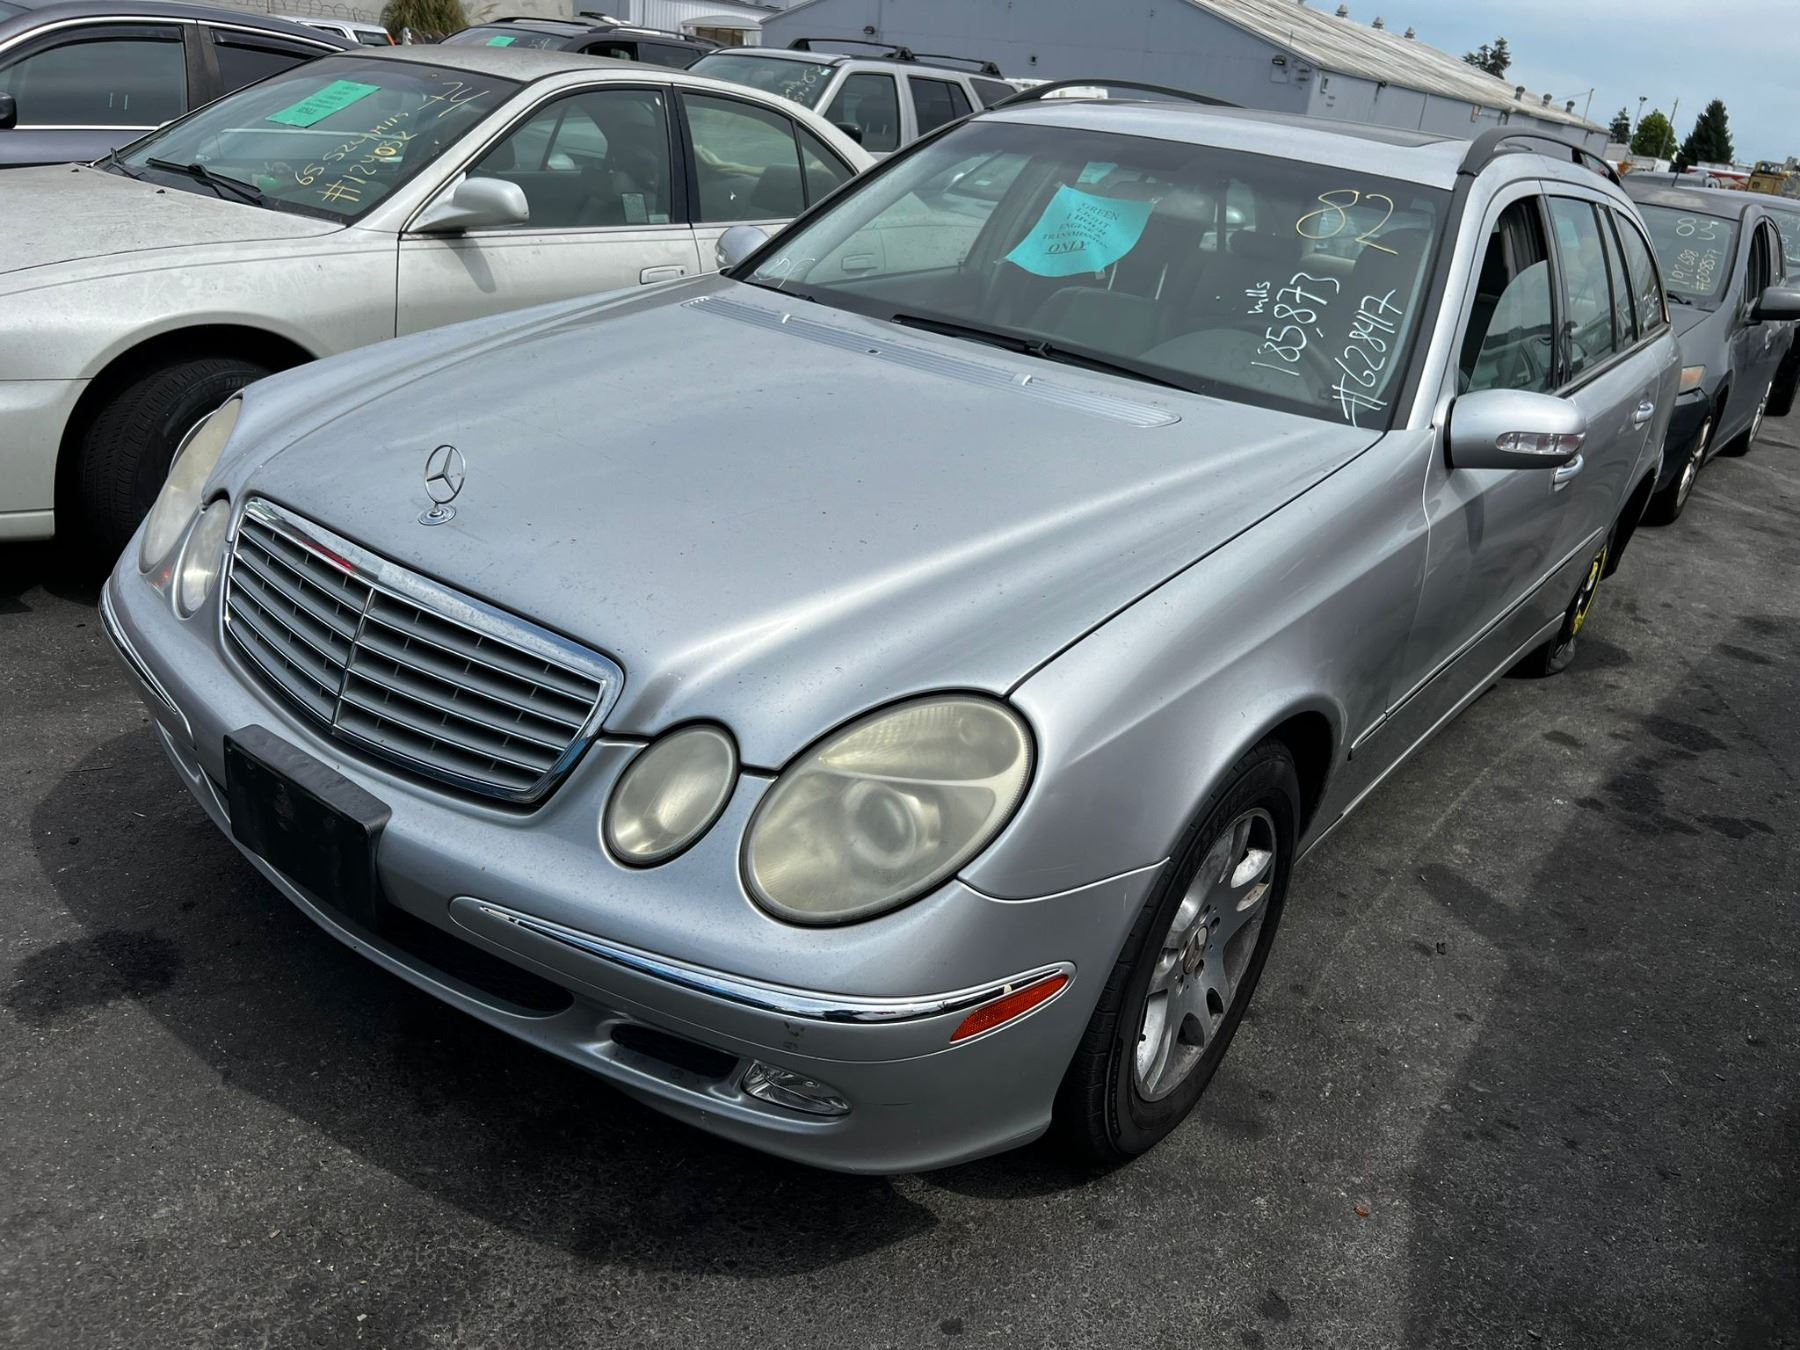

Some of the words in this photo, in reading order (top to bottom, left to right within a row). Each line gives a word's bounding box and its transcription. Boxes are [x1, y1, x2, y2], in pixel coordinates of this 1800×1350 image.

[1081, 202, 1120, 221] GREEN
[1296, 189, 1399, 255] 82
[1047, 240, 1090, 253] ONLY
